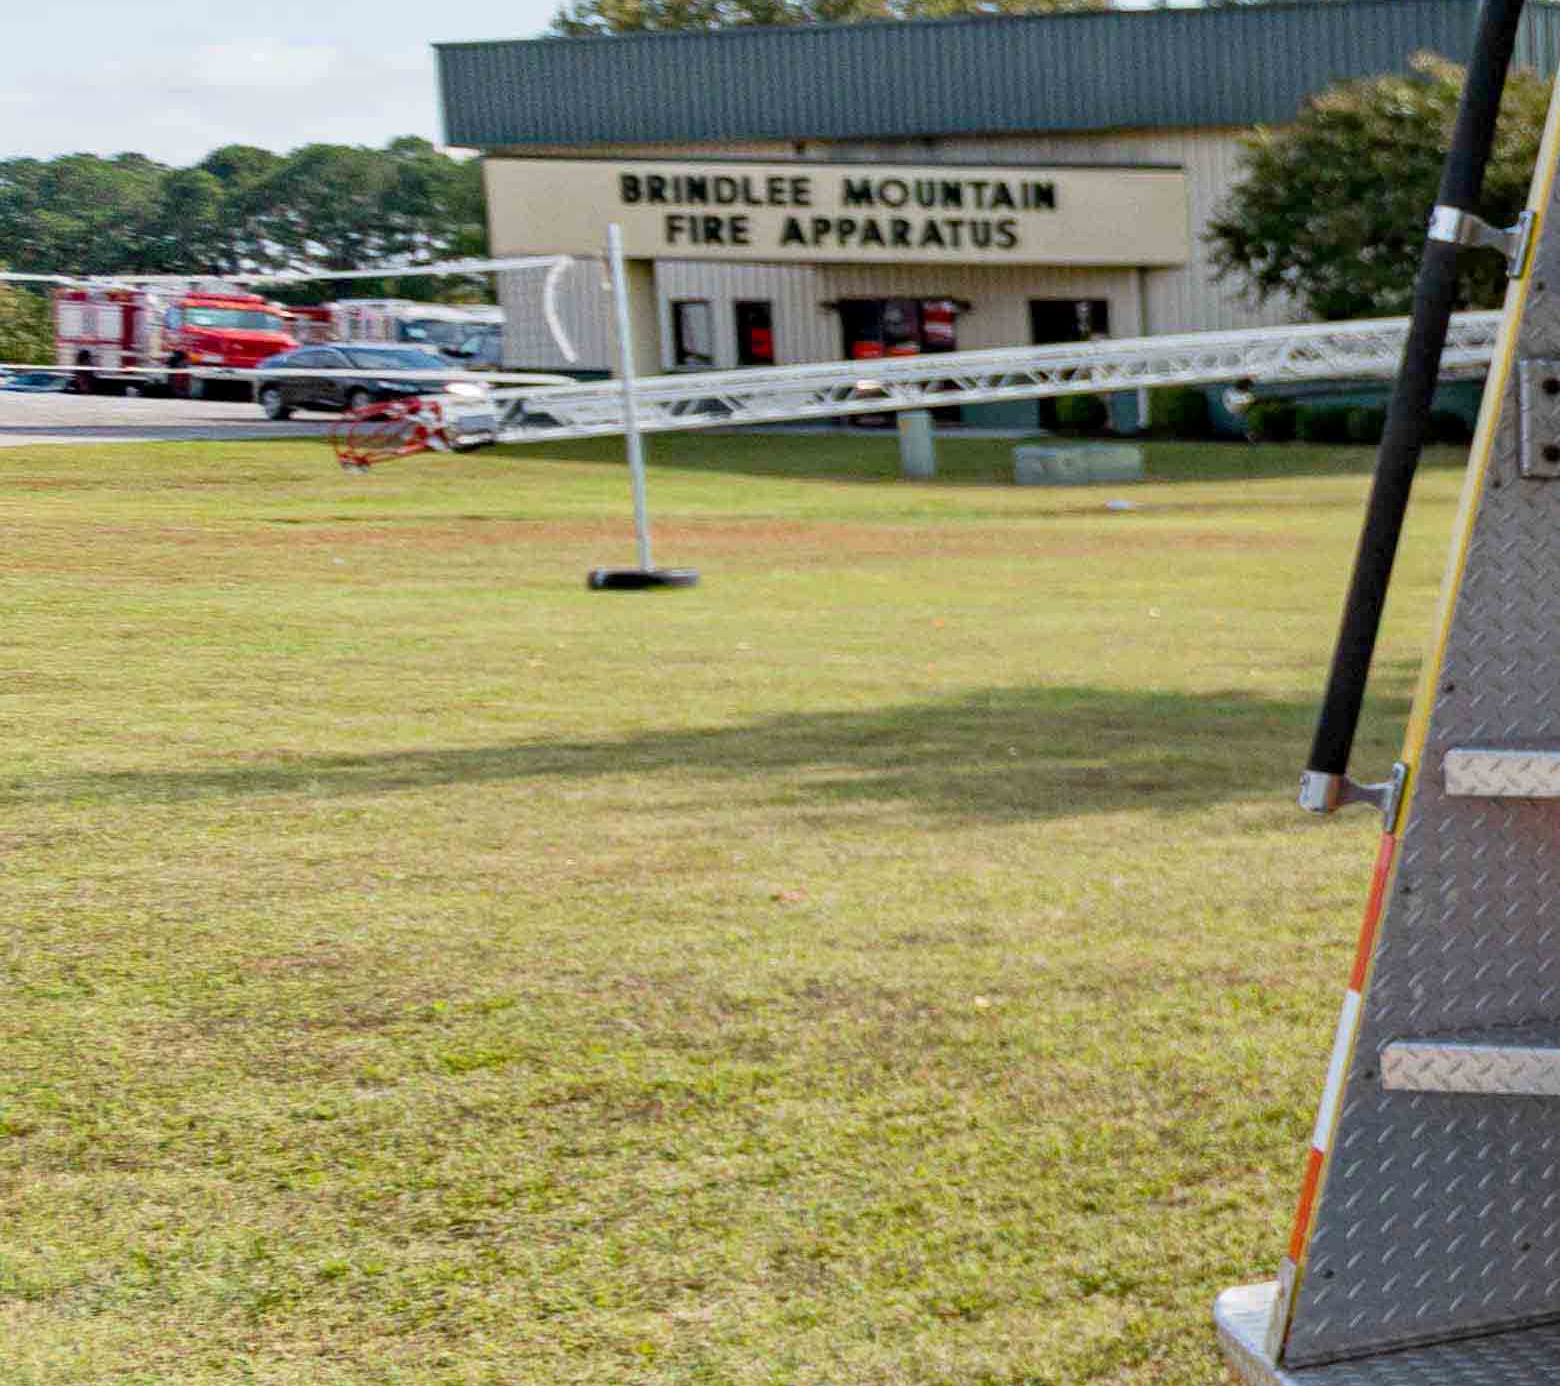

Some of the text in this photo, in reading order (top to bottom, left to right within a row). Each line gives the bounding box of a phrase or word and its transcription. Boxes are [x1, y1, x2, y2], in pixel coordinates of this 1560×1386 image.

[619, 173, 1057, 211] BRINDLEE MOUNTAIN
[665, 215, 1019, 250] FIRE APPARATUS
